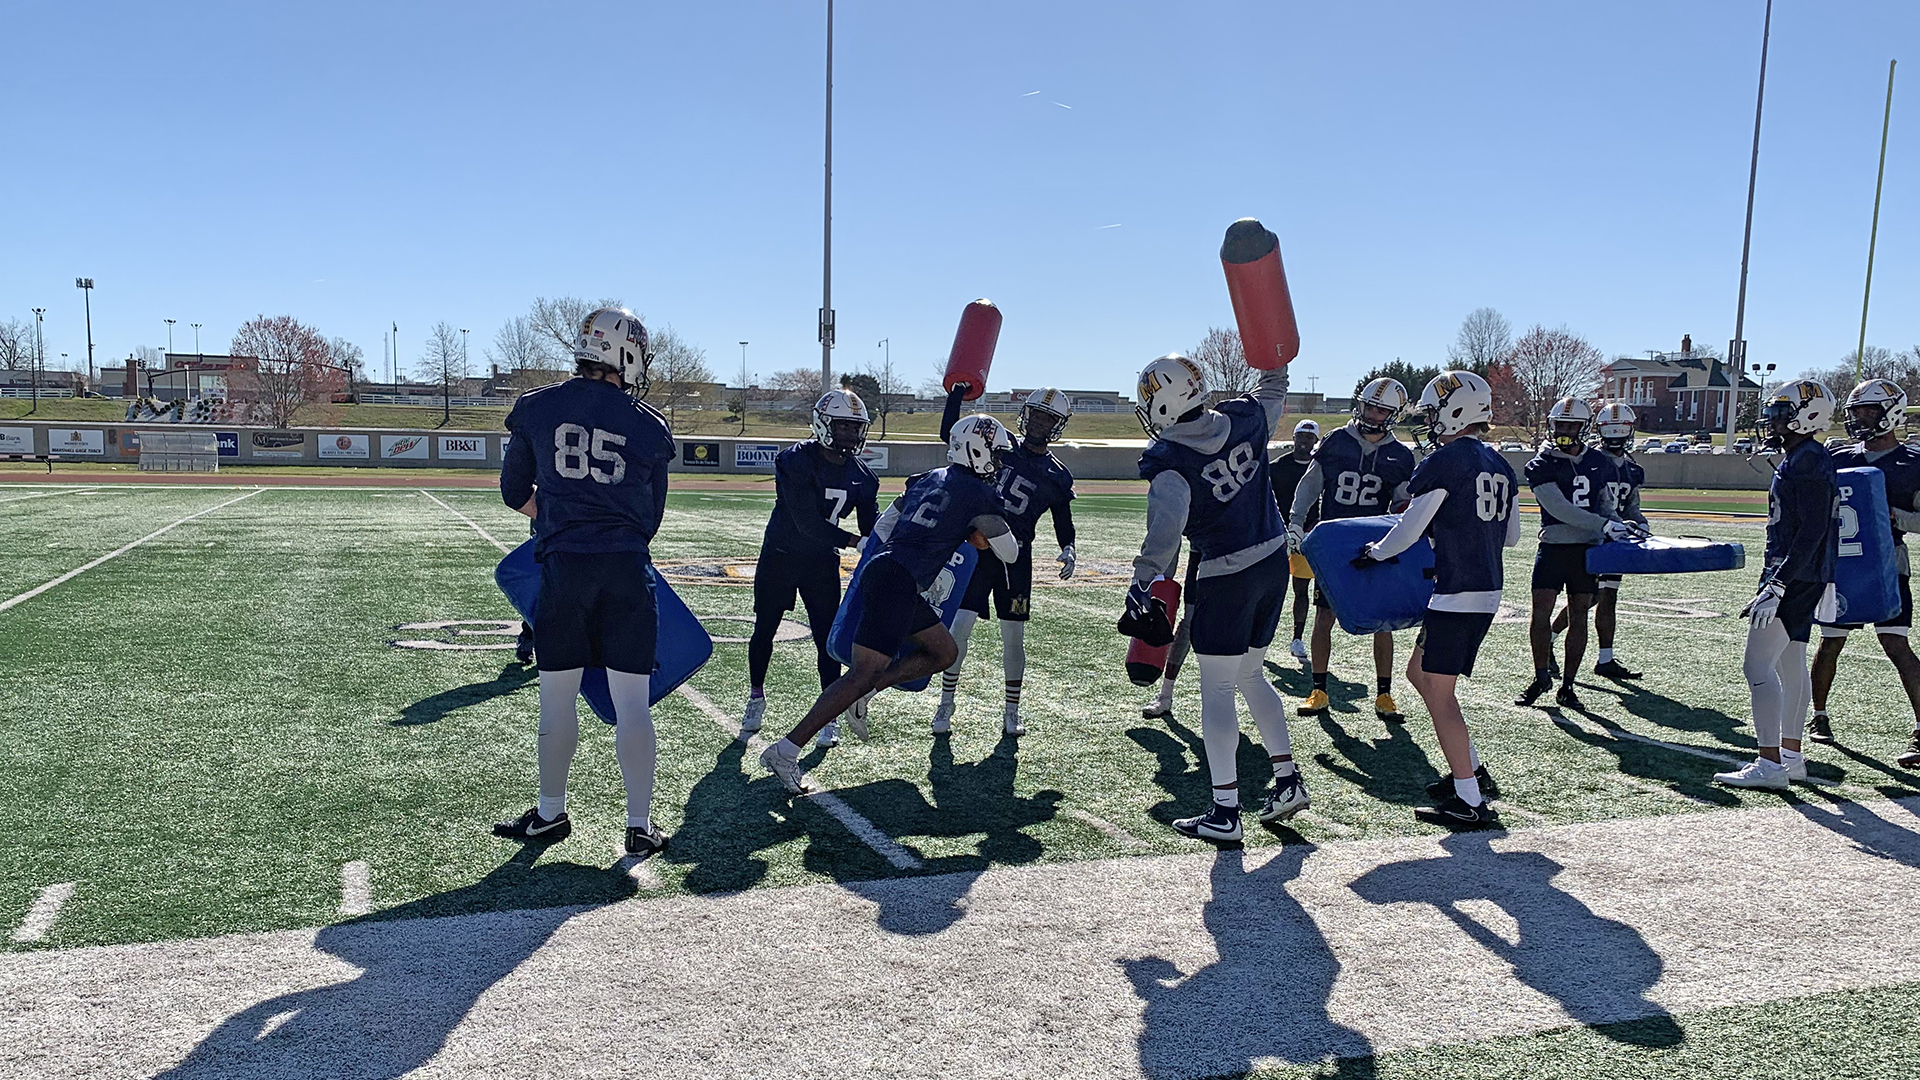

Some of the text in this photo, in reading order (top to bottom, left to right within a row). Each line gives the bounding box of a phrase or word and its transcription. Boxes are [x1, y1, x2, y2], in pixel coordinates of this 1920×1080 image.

[216, 438, 236, 448] ank
[445, 439, 480, 452] BB&T
[554, 422, 627, 485] 85
[1201, 441, 1260, 503] 88
[1334, 470, 1383, 506] 82
[825, 487, 847, 526] 7
[908, 487, 950, 528] 2
[1572, 475, 1591, 507] 2
[1838, 485, 1854, 502] P
[948, 551, 965, 567] P
